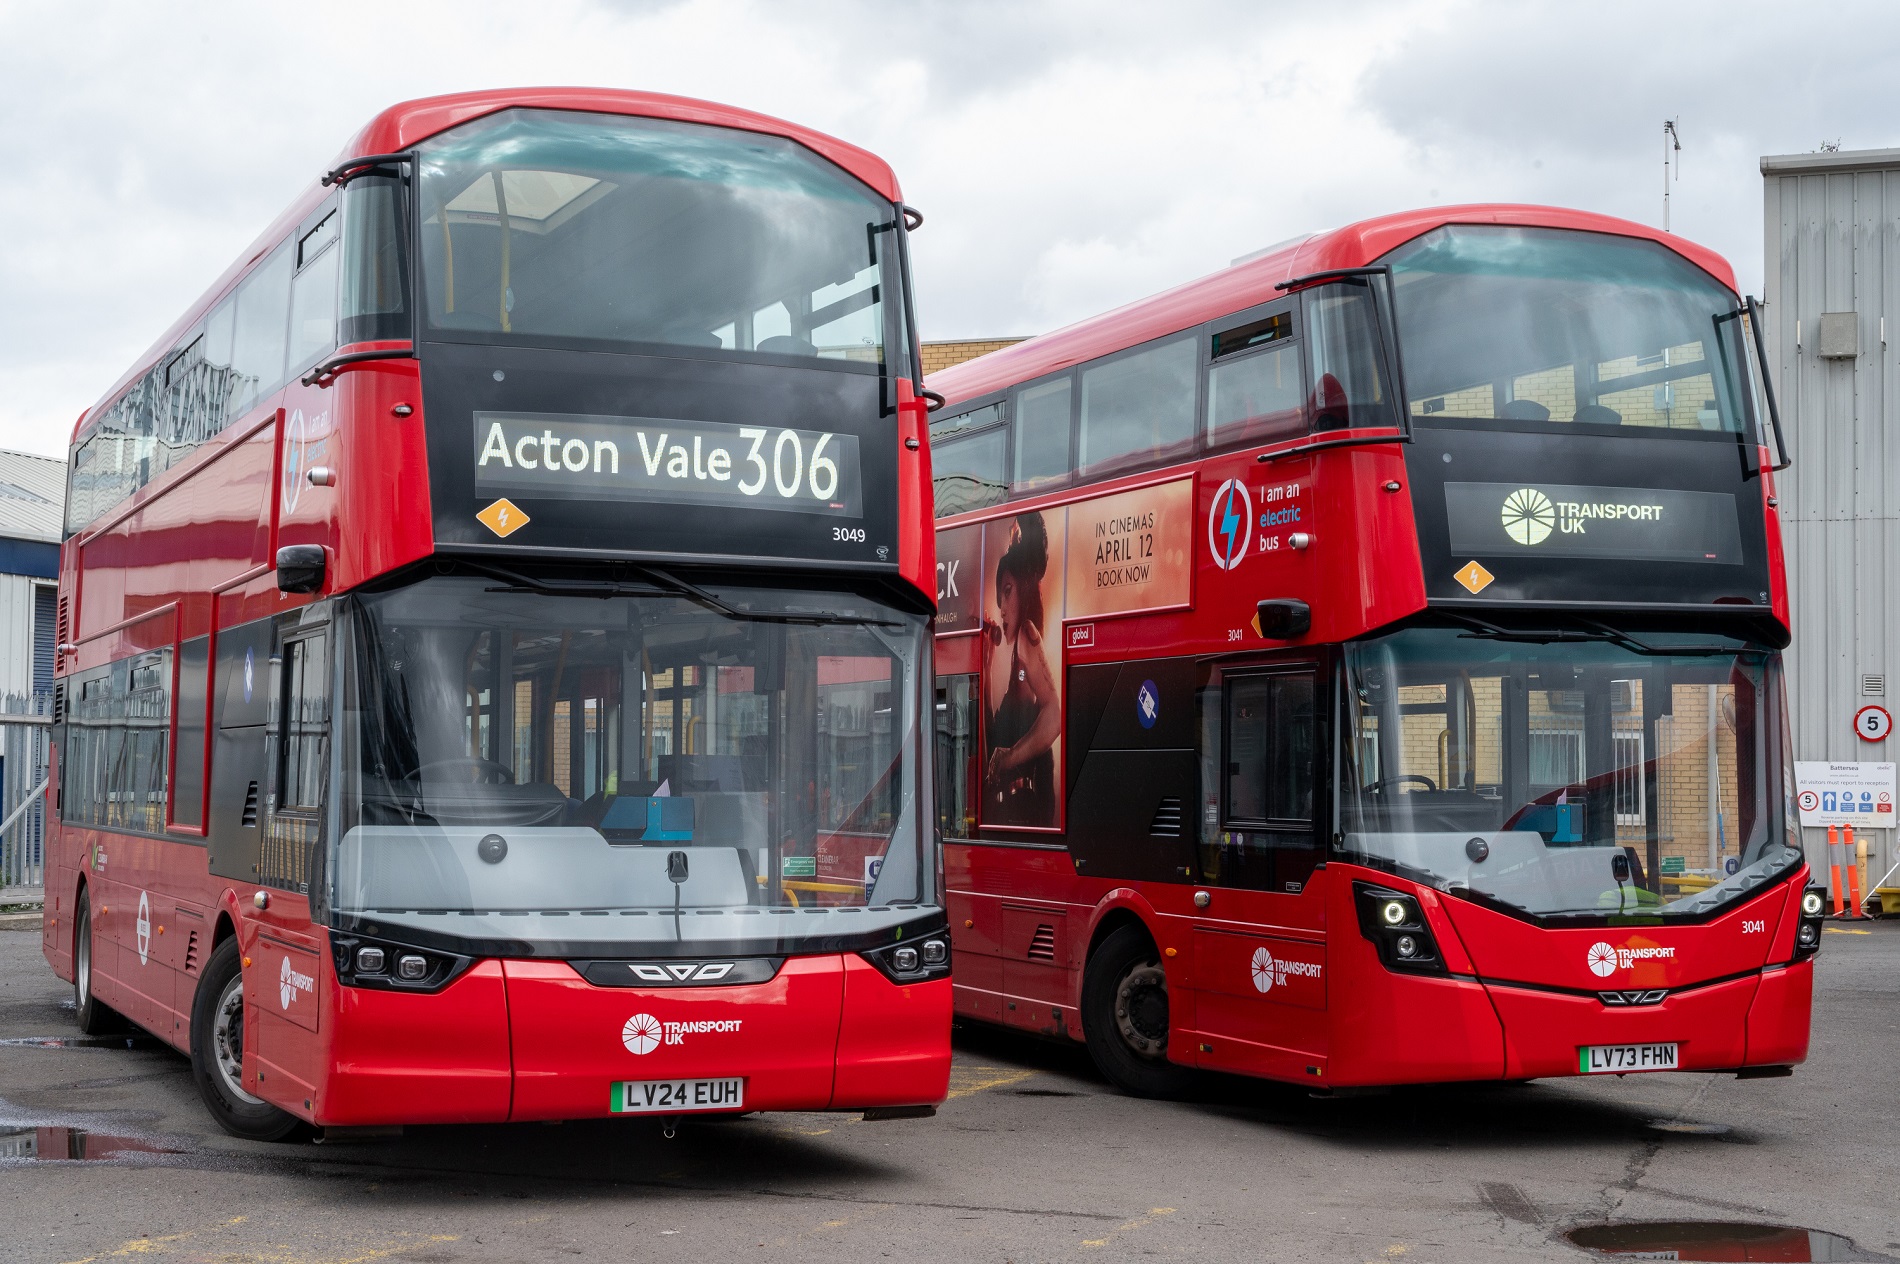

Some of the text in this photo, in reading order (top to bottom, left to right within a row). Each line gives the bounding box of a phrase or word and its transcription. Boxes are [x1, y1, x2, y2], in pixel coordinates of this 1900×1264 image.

[478, 422, 839, 500] Acton Vale 306
[1260, 483, 1300, 503] I am an
[1260, 504, 1301, 527] electric
[1557, 502, 1664, 521] TRANSPORT
[1095, 512, 1154, 538] IN CINEMAS
[1560, 518, 1586, 534] UK
[832, 527, 866, 542] 3049
[1260, 533, 1279, 551] bus
[1095, 533, 1153, 566] APRIL 12
[937, 560, 960, 600] CK
[1097, 565, 1150, 587] BOOK NOW
[936, 612, 958, 623] NHALGH
[1072, 627, 1089, 645] global
[1227, 628, 1243, 641] 3041
[1867, 716, 1879, 731] 5
[1805, 795, 1812, 804] 5
[1741, 920, 1765, 934] 3041
[1617, 947, 1675, 959] TRANSPORT
[1274, 959, 1322, 978] TRANSPORT
[1619, 958, 1634, 968] UK
[1275, 972, 1287, 986] UK
[663, 1020, 742, 1034] TRANSPORT
[665, 1033, 684, 1045] UK
[1591, 1045, 1675, 1068] LV73 FHN
[627, 1081, 738, 1107] LV24 EUH
